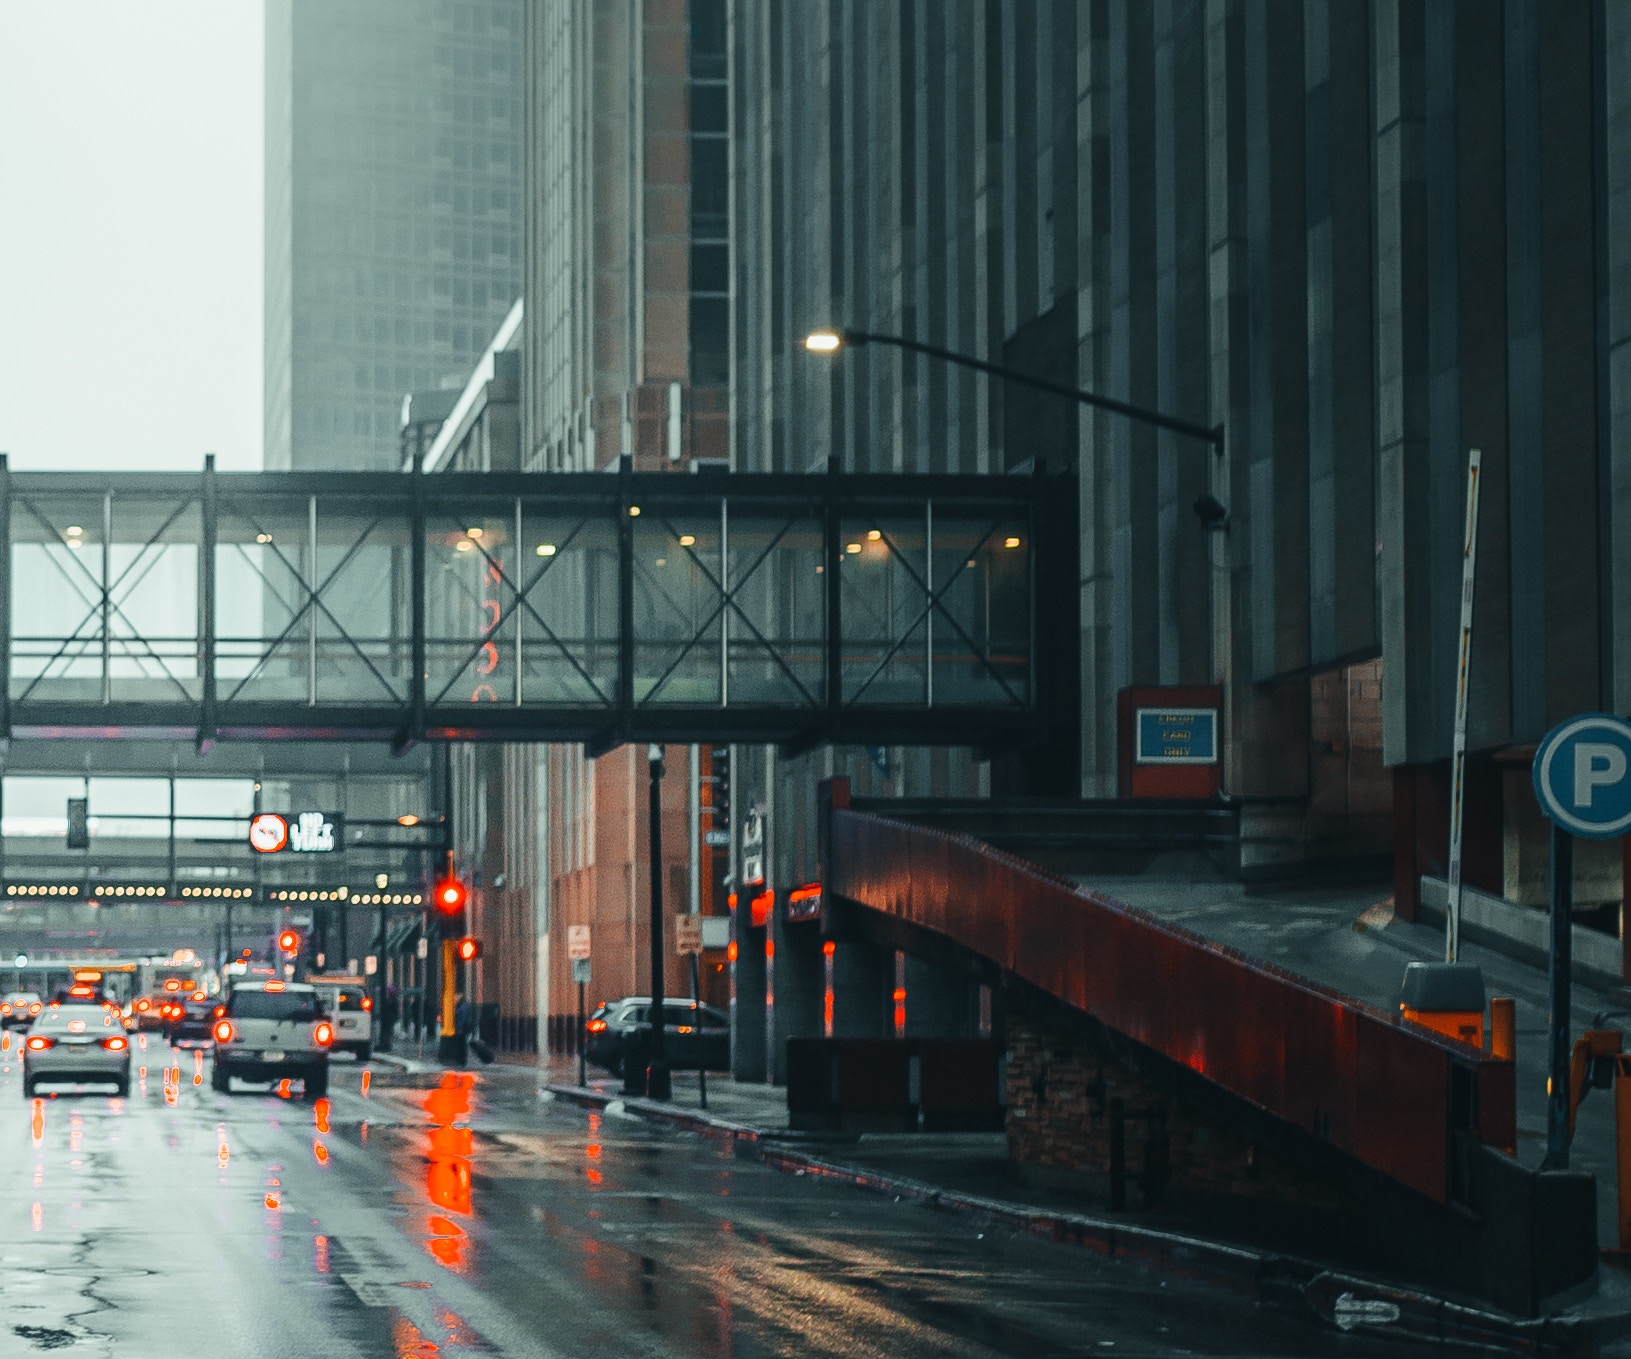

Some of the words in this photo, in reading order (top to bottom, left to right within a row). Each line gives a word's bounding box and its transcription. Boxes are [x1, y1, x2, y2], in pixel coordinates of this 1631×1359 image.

[1162, 730, 1192, 742] CARD
[1164, 746, 1191, 757] ONLY
[1573, 742, 1628, 808] P
[290, 823, 334, 838] LEFT
